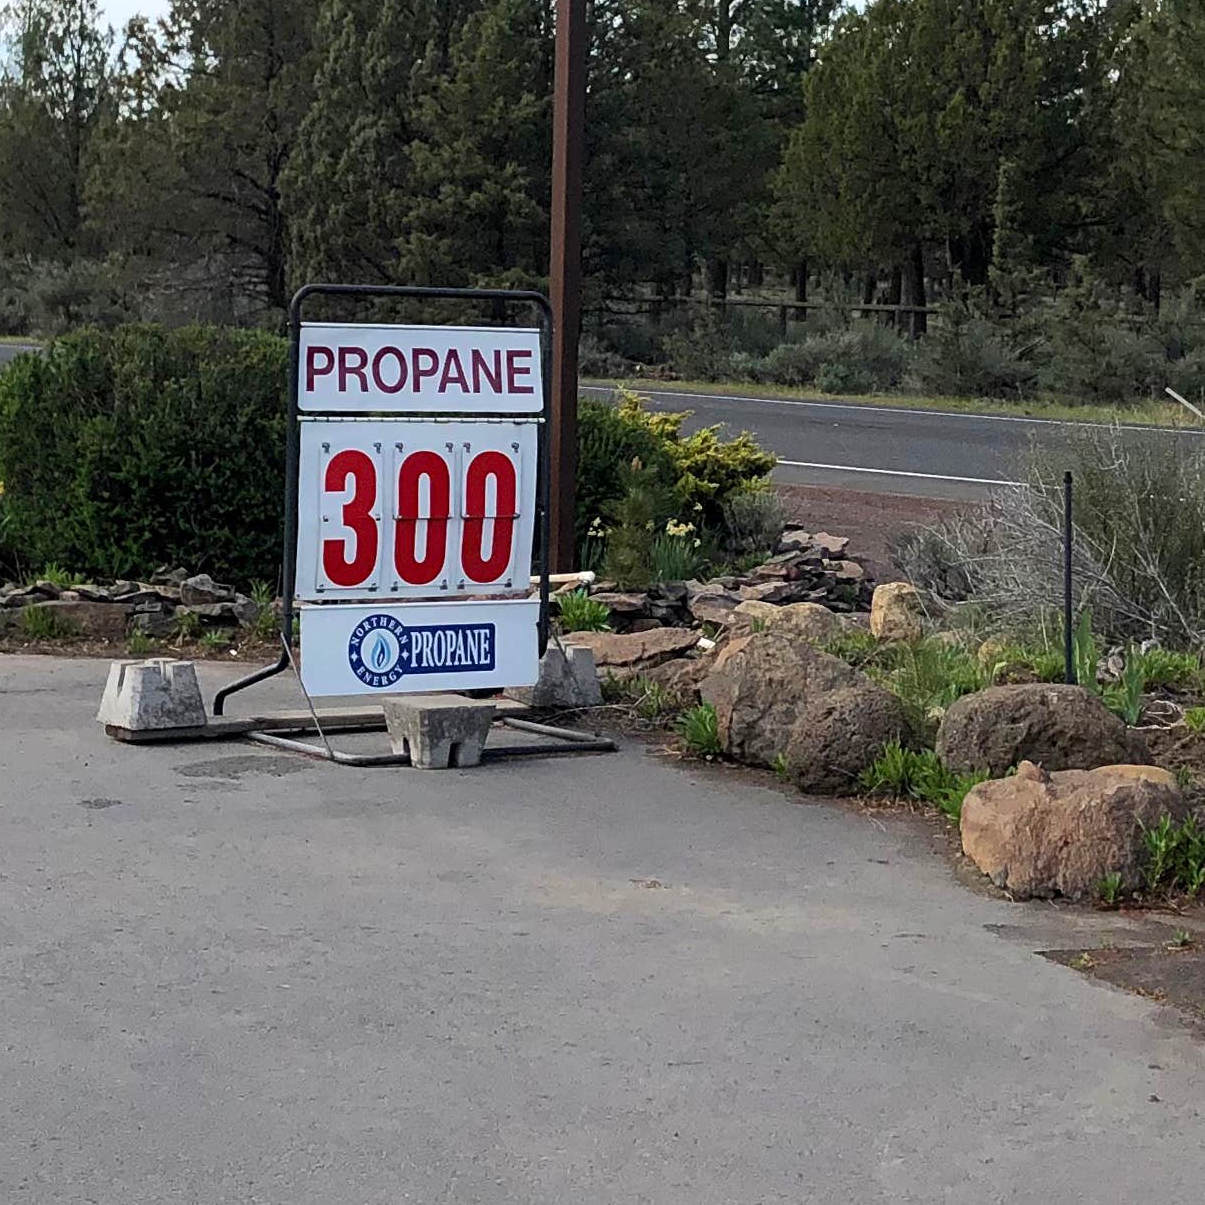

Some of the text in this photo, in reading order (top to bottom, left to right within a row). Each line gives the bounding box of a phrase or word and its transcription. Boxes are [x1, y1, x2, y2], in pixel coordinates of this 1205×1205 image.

[305, 345, 535, 395] PROPANE
[322, 449, 517, 587] 300
[350, 616, 409, 646] NORTHERN
[410, 628, 491, 668] PROPANE
[356, 663, 403, 687] ENERGY
